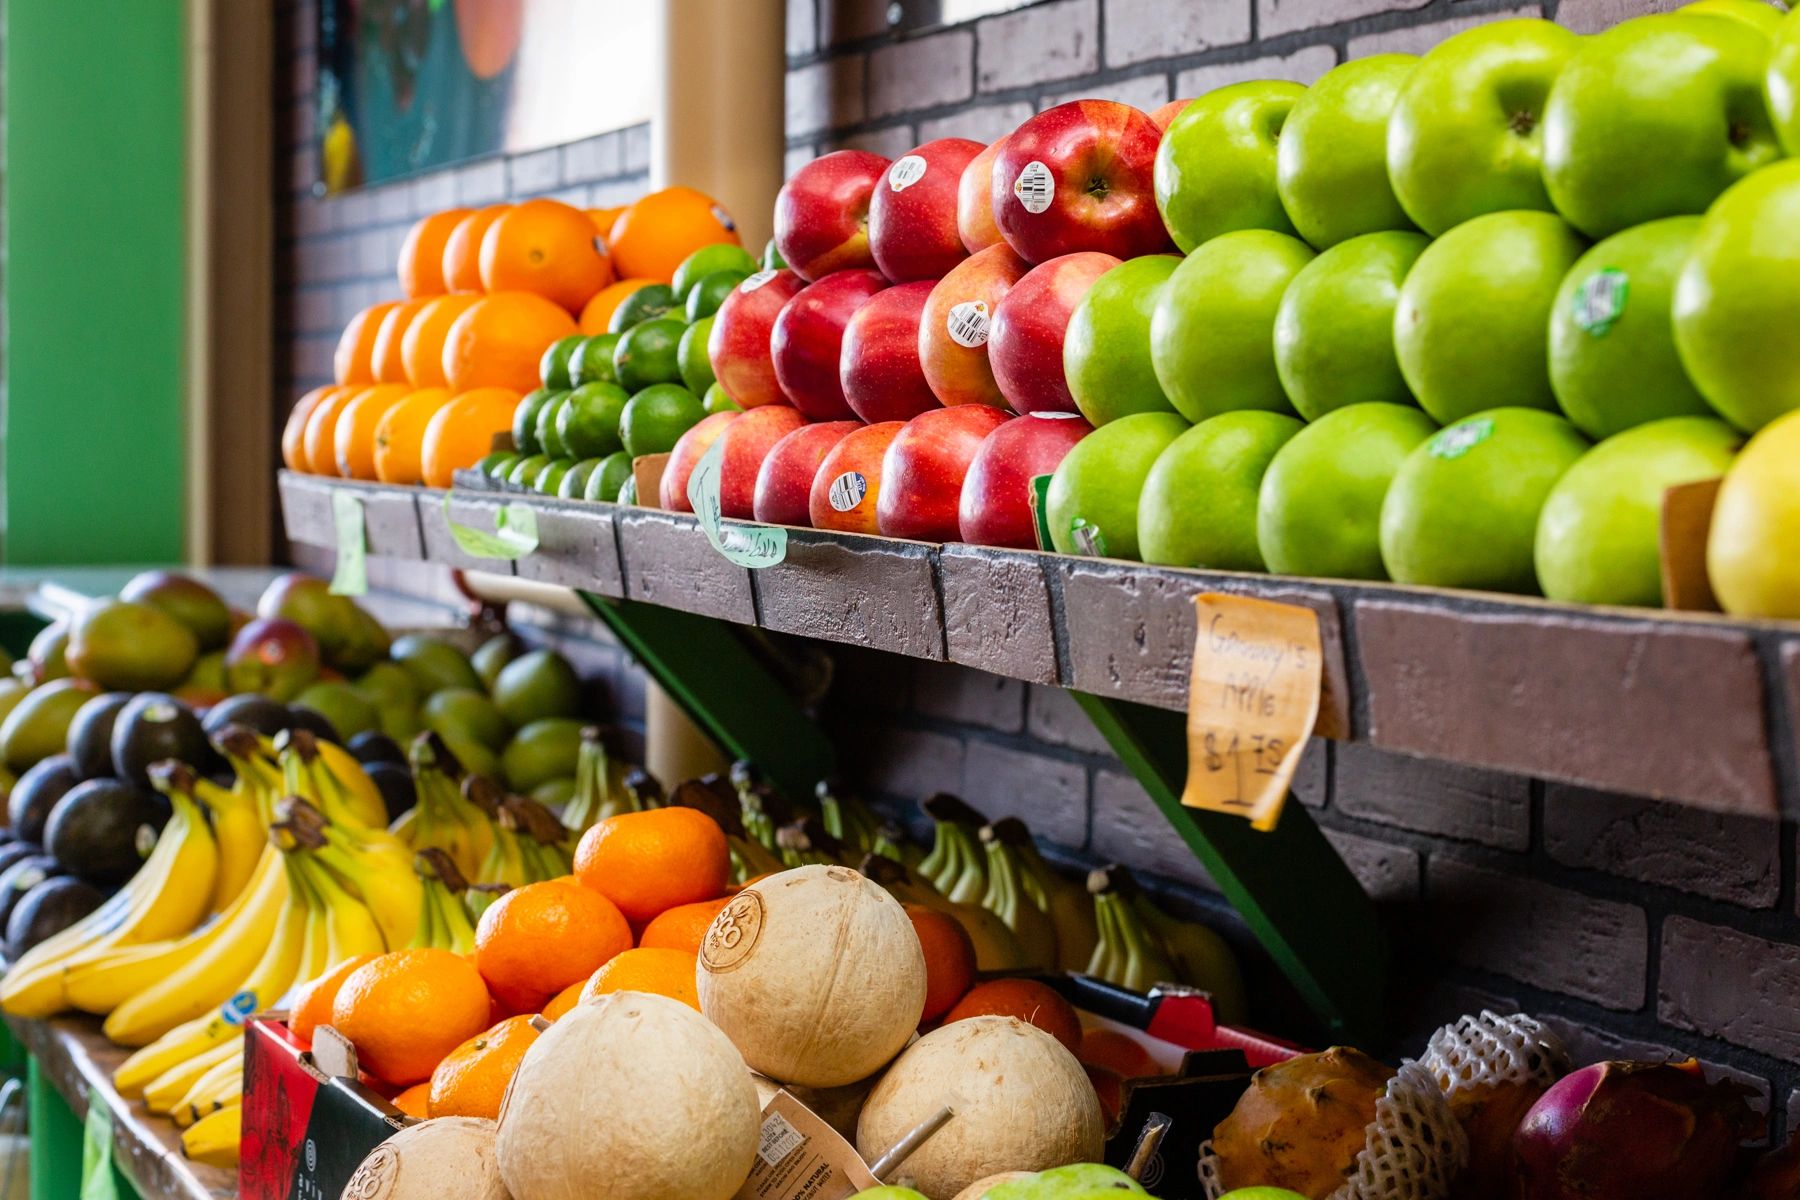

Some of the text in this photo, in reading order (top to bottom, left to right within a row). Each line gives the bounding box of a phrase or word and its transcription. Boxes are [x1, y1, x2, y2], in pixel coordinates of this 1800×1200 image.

[762, 1129, 790, 1153] BEST BEFORE
[803, 1162, 829, 1190] NATURAL
